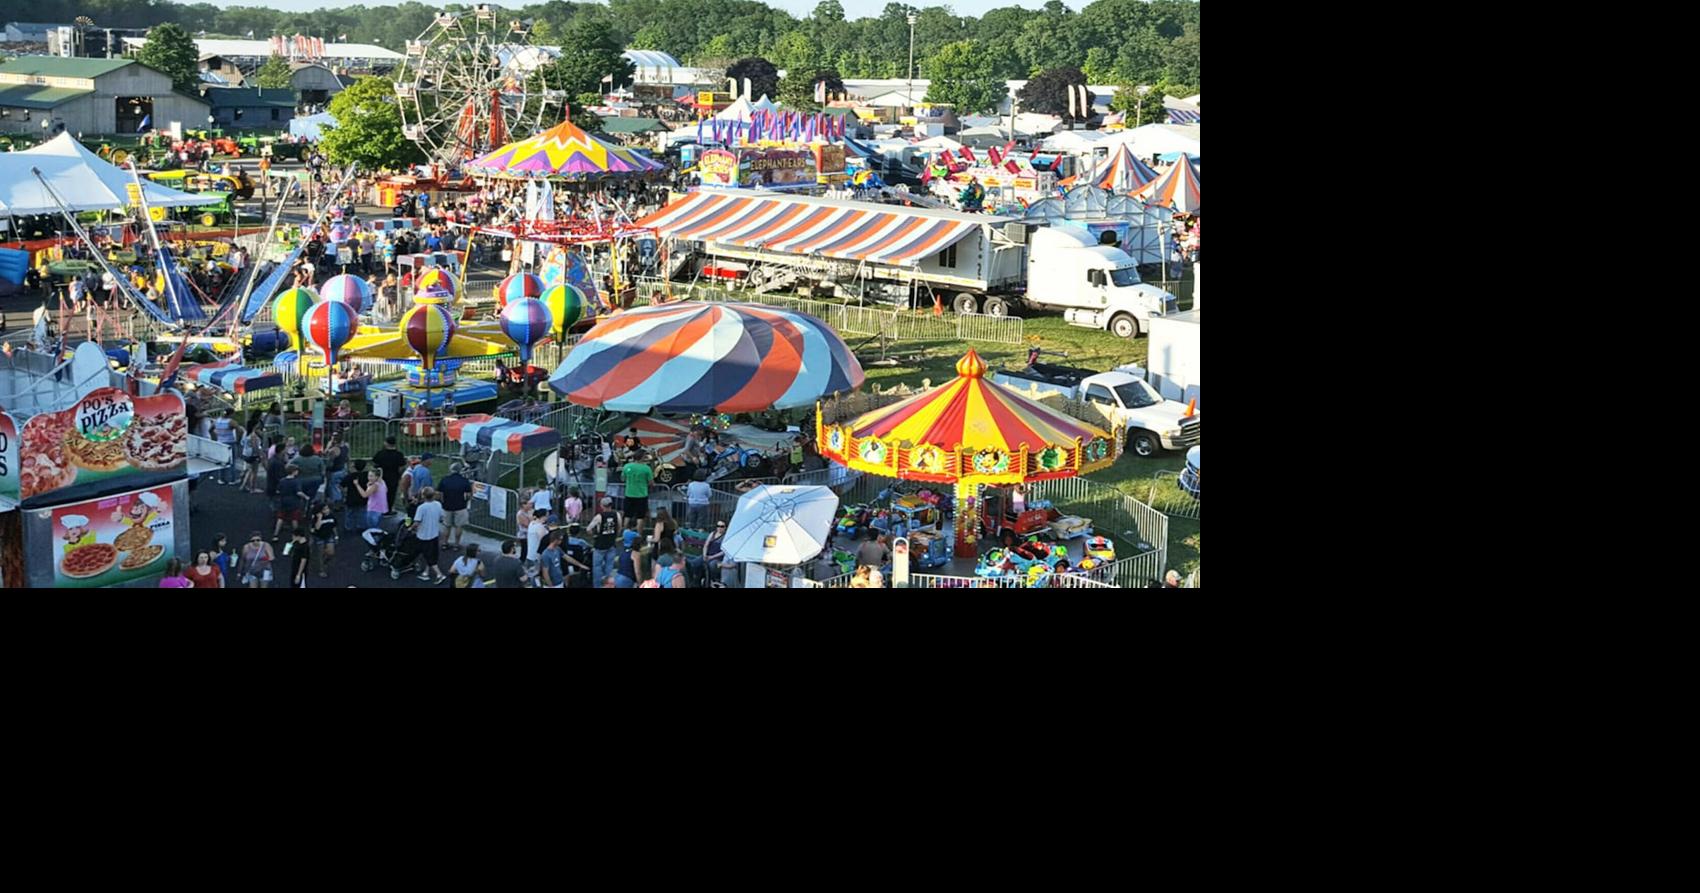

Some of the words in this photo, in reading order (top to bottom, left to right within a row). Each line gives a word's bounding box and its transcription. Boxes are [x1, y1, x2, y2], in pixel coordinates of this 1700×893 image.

[750, 157, 786, 171] ELEPHANT
[788, 157, 806, 169] EARS
[82, 395, 114, 414] PO'S
[80, 401, 130, 434] PIZZA
